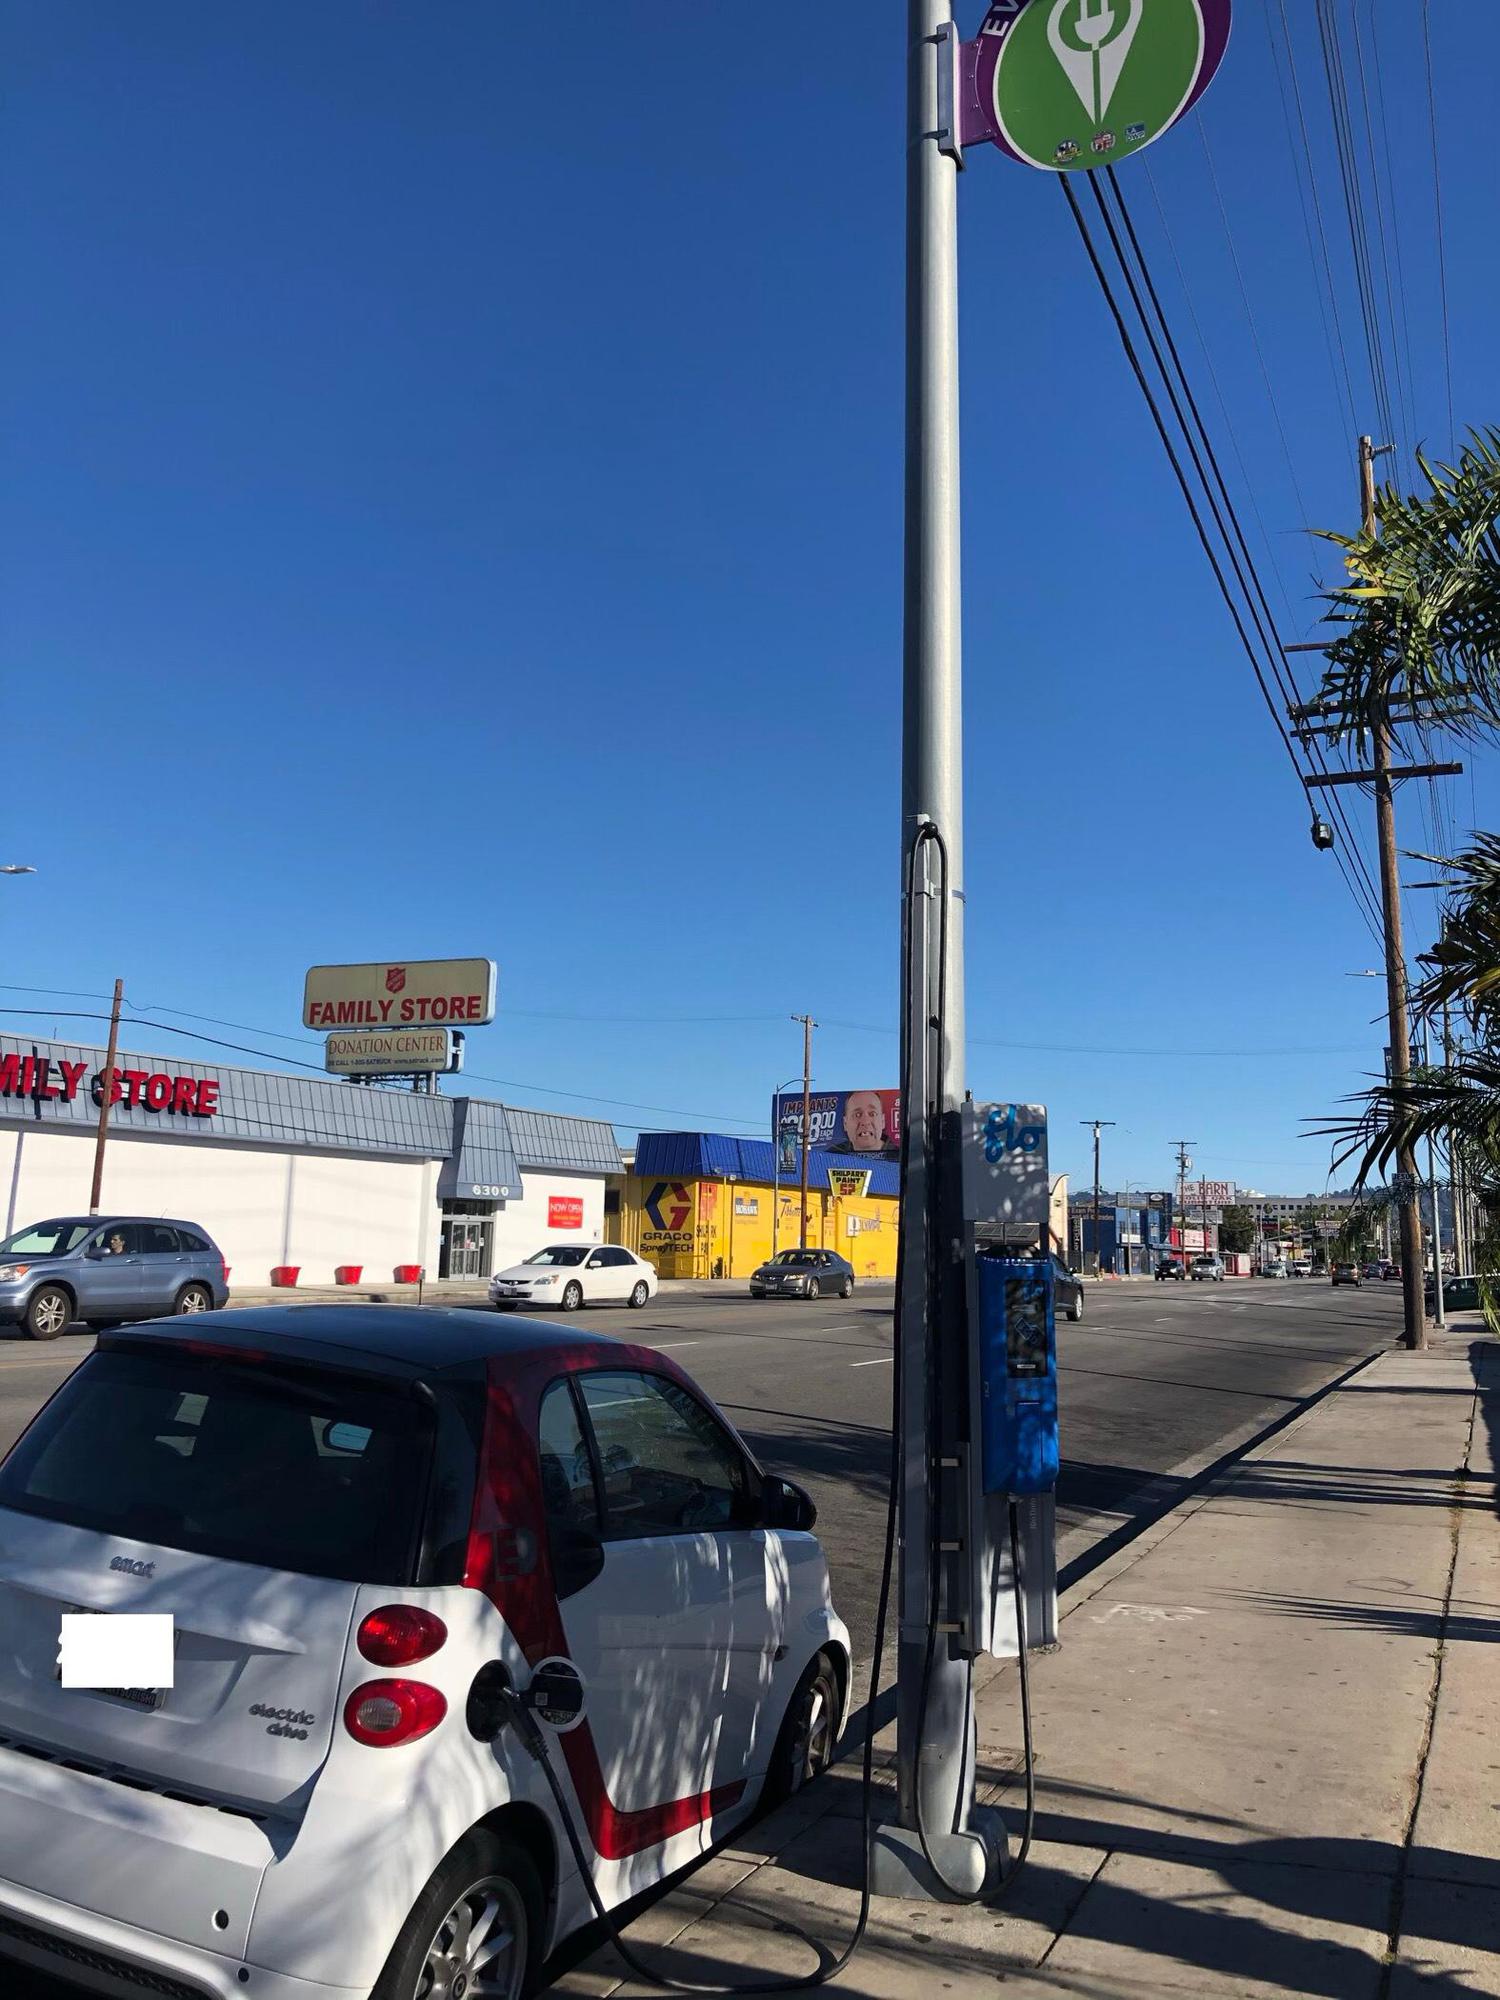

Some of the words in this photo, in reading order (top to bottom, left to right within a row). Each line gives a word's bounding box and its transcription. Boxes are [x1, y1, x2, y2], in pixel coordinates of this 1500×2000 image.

[309, 1000, 394, 1025] FAMILY
[400, 996, 482, 1022] STORE
[328, 1037, 394, 1055] DONATION
[396, 1036, 445, 1052] CENTER
[98, 1065, 220, 1115] STORE
[782, 1097, 839, 1116] IMPANTS
[983, 1104, 1046, 1164] flo
[472, 1184, 509, 1197] 6300
[1198, 1183, 1229, 1195] BARN
[550, 1202, 568, 1213] NOW
[643, 1232, 693, 1241] GRACO
[109, 1556, 156, 1578] smart
[248, 1703, 315, 1726] electric
[265, 1723, 309, 1741] drive
